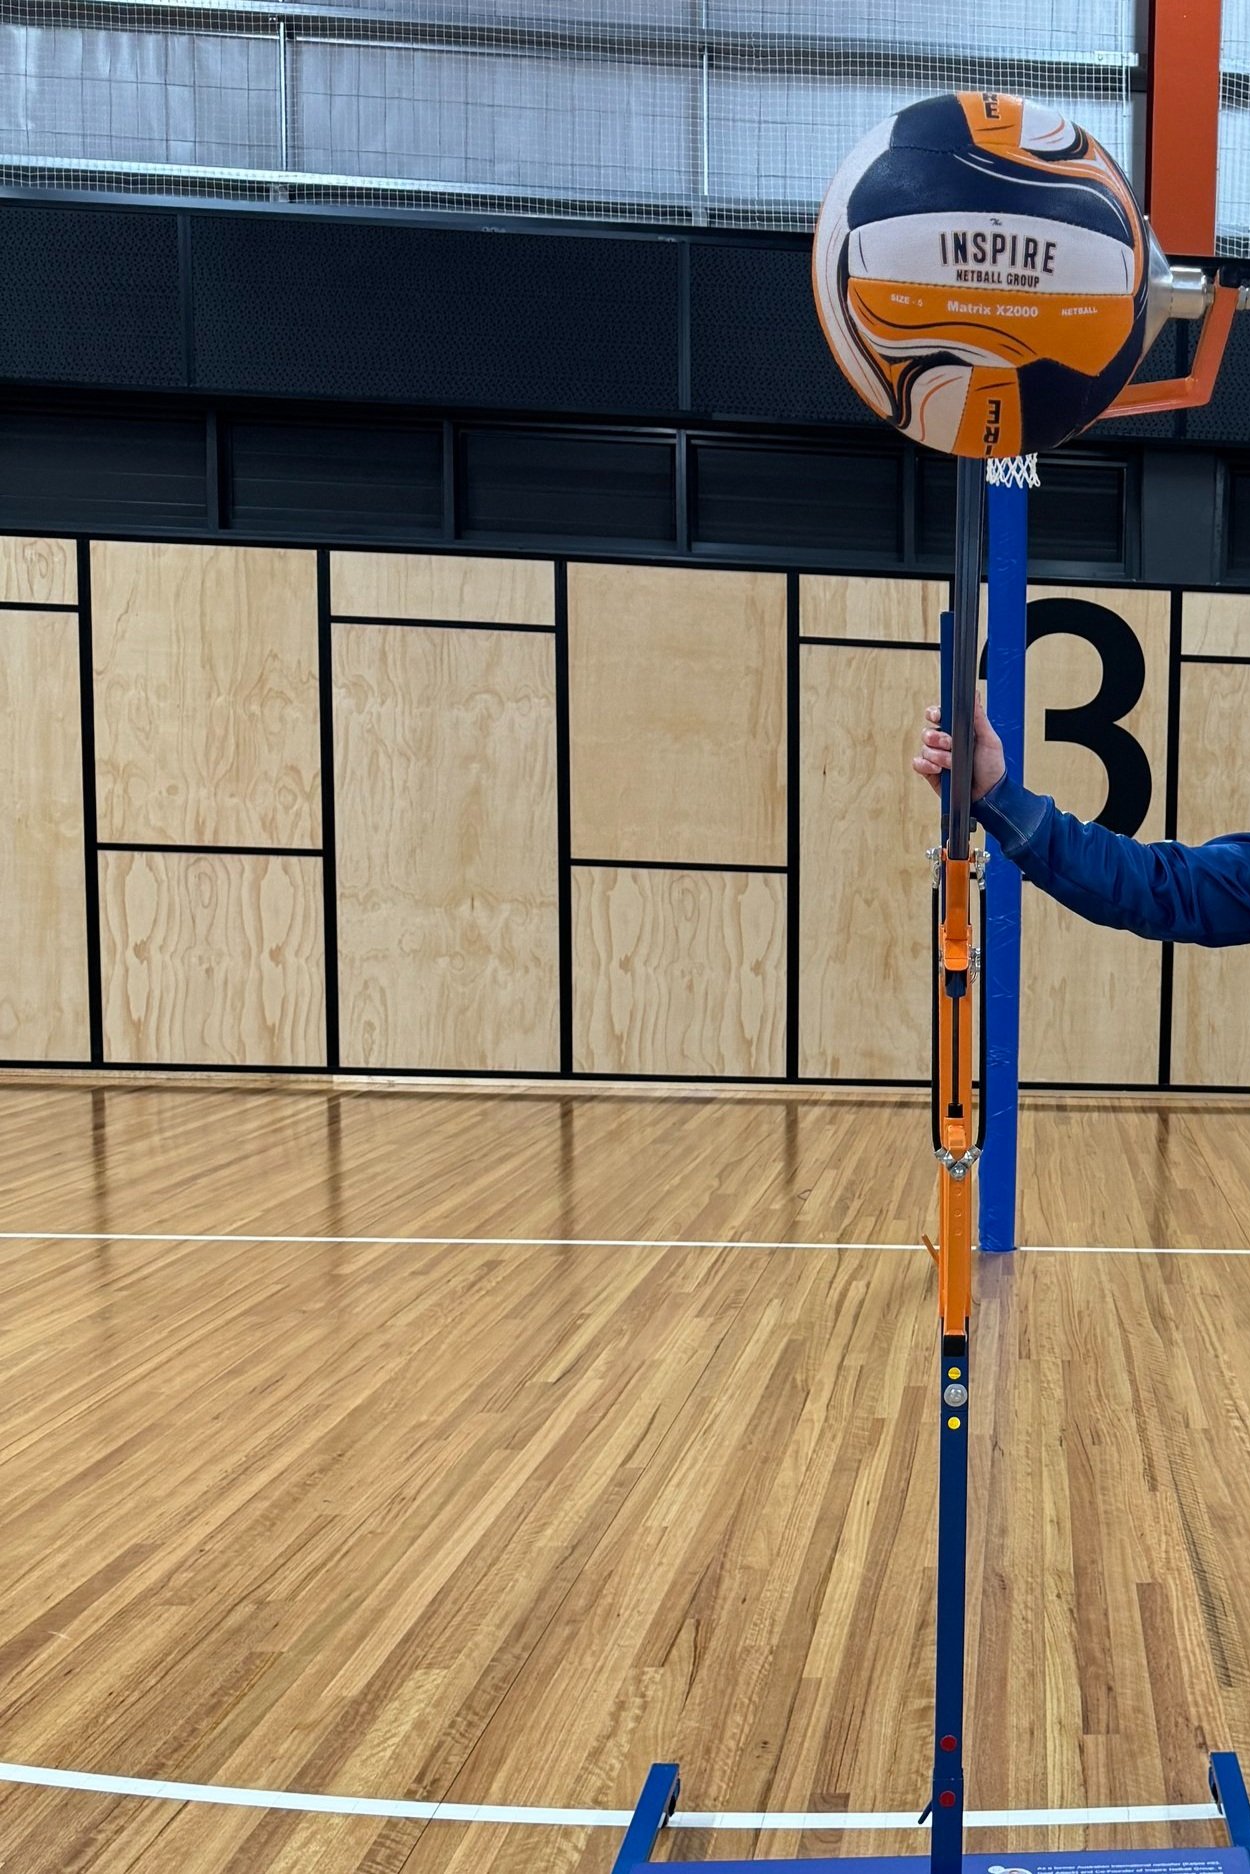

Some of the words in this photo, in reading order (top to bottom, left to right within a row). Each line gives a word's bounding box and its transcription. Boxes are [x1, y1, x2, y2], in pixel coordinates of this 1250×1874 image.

[938, 231, 1058, 276] INSPIRE
[956, 269, 1002, 285] NETBALL
[1006, 273, 1040, 289] GROUP
[890, 293, 910, 305] SIZE
[947, 300, 991, 315] Matrix
[996, 305, 1039, 318] X2000
[1061, 306, 1098, 316] NETBALL
[979, 597, 1152, 839] 3
